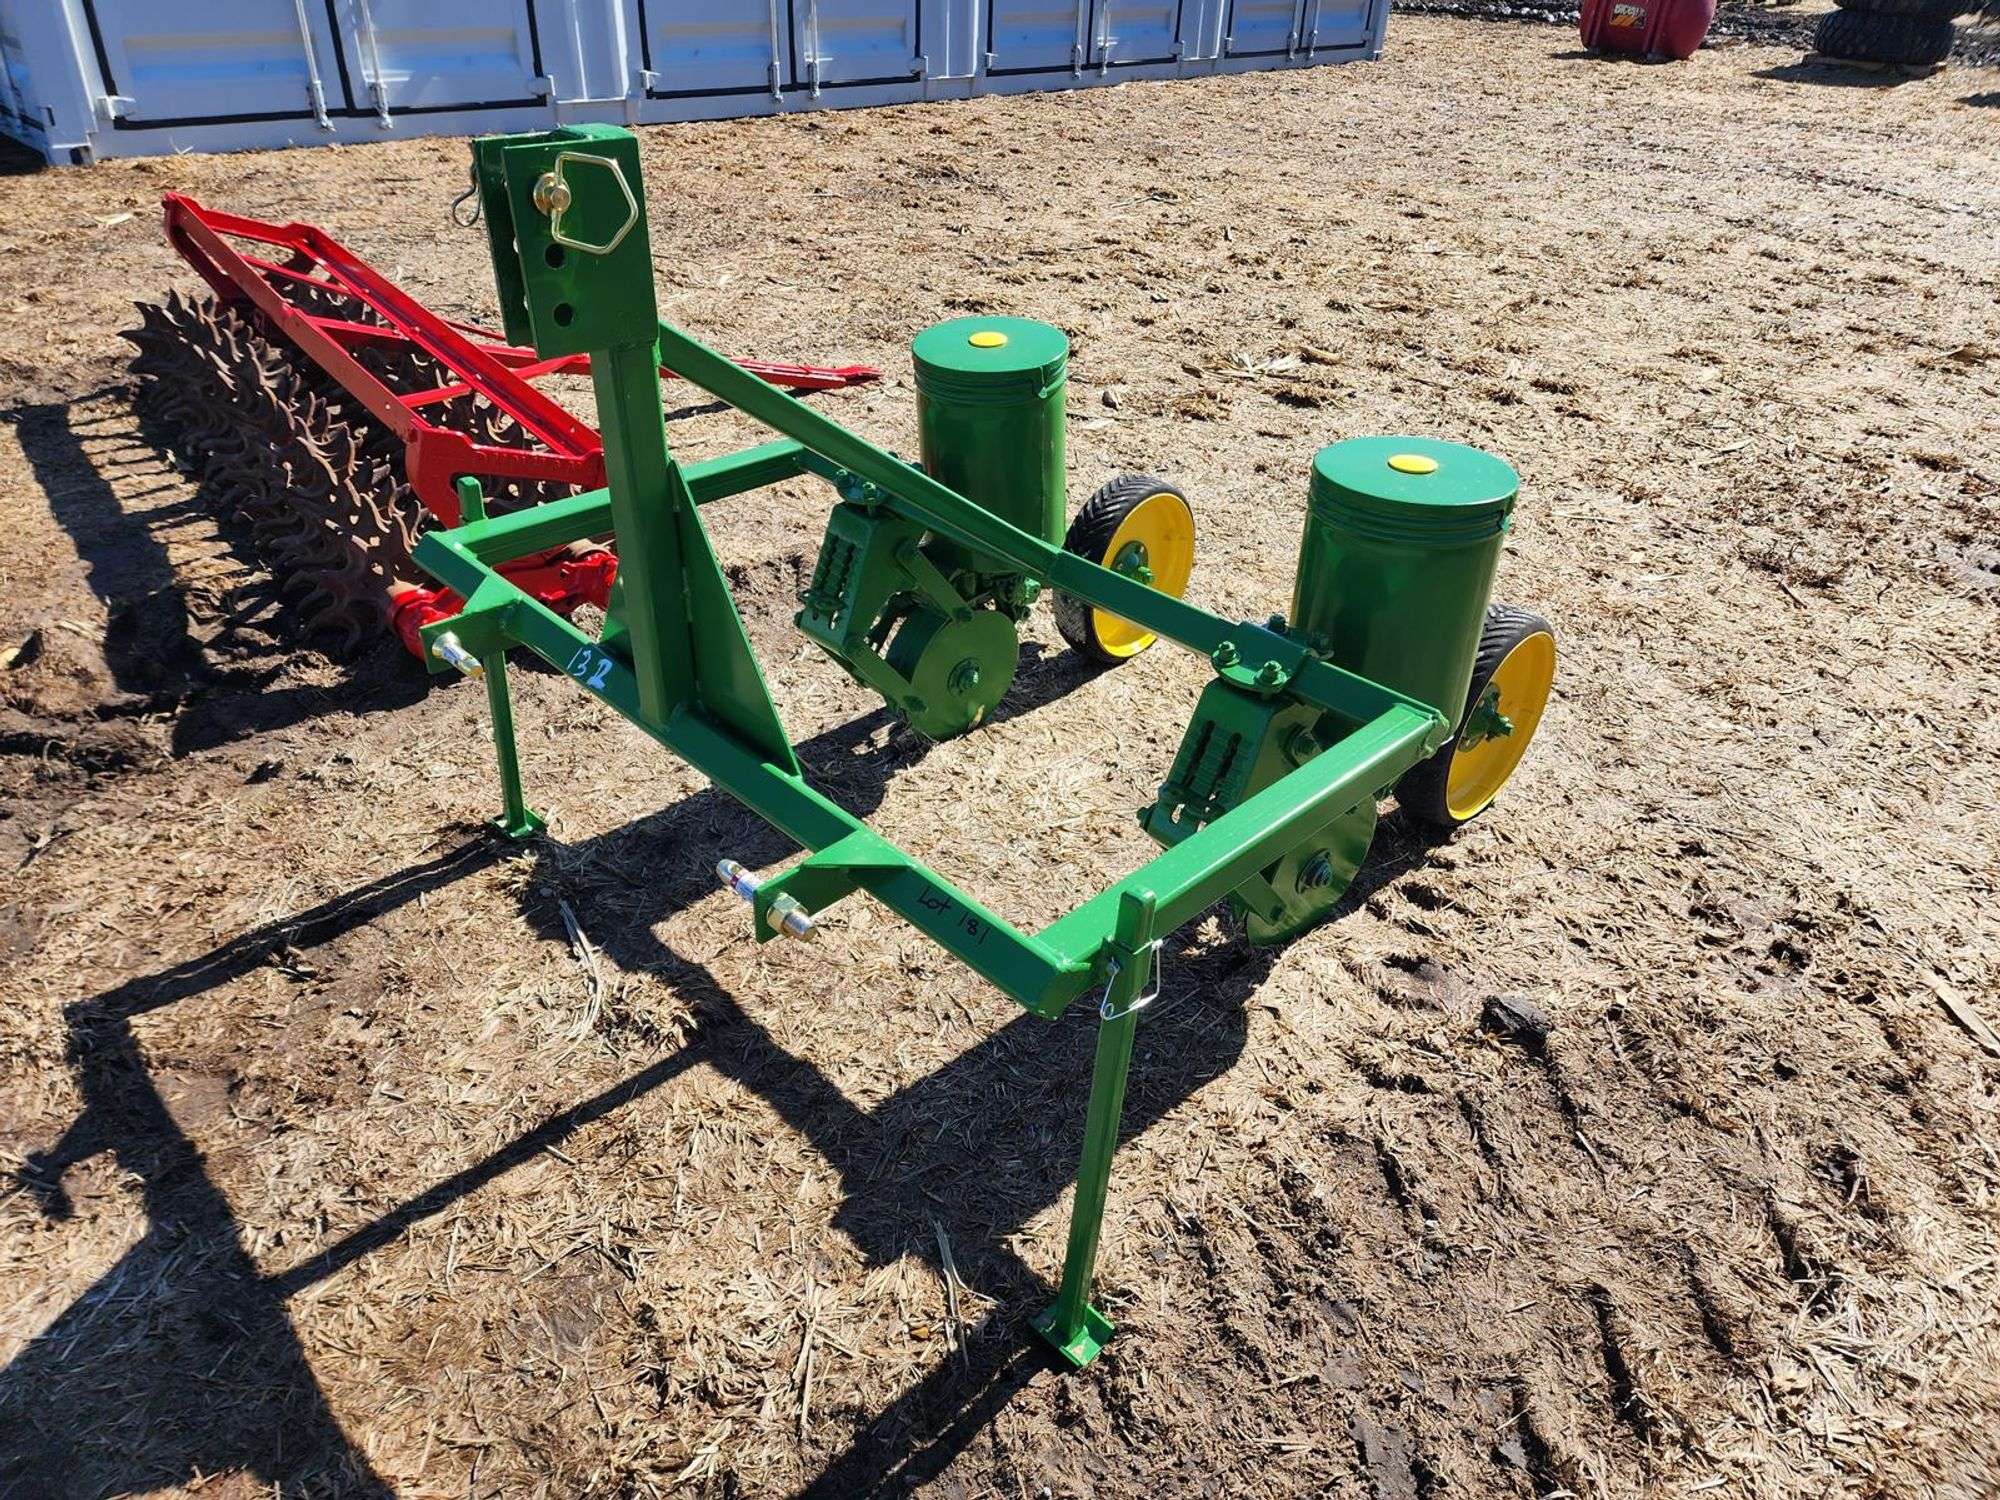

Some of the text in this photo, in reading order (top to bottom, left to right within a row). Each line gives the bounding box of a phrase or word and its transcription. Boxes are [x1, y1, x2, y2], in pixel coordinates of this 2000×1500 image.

[566, 647, 613, 689] 132
[918, 885, 991, 945] Lot 181
